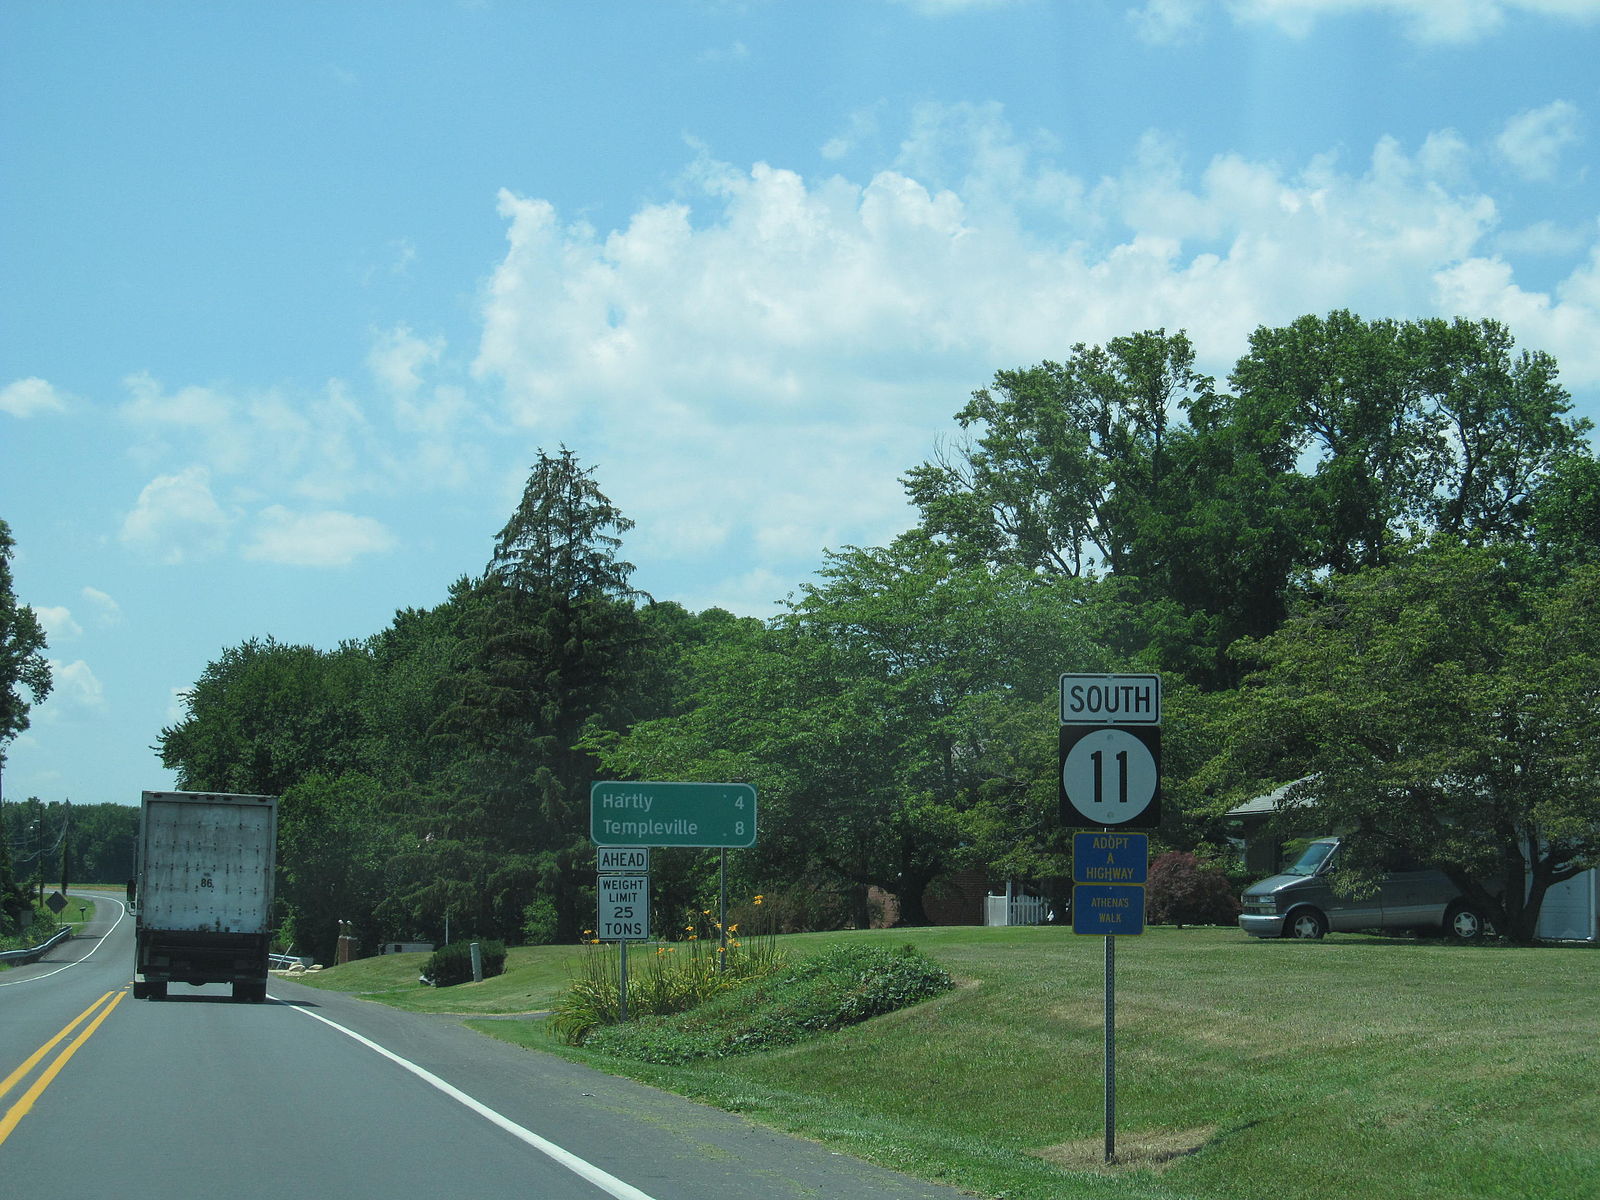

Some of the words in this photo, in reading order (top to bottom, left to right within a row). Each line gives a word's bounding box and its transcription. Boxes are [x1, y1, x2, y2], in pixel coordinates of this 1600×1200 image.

[1069, 685, 1150, 713] SOUTH
[1090, 750, 1128, 803] 11
[602, 793, 653, 812] Hartly
[735, 796, 744, 810] 4
[603, 819, 698, 838] Templeville
[735, 821, 744, 835] 8
[1092, 836, 1129, 849] ADOPT
[602, 852, 645, 867] AHEAD
[1107, 852, 1114, 864] A
[1086, 866, 1135, 880] HIGHWAY
[603, 879, 644, 890] WEIGHT
[609, 893, 637, 903] LIMIT
[614, 906, 634, 919] 25
[1098, 912, 1122, 923] WALK
[605, 922, 642, 935] TONS
